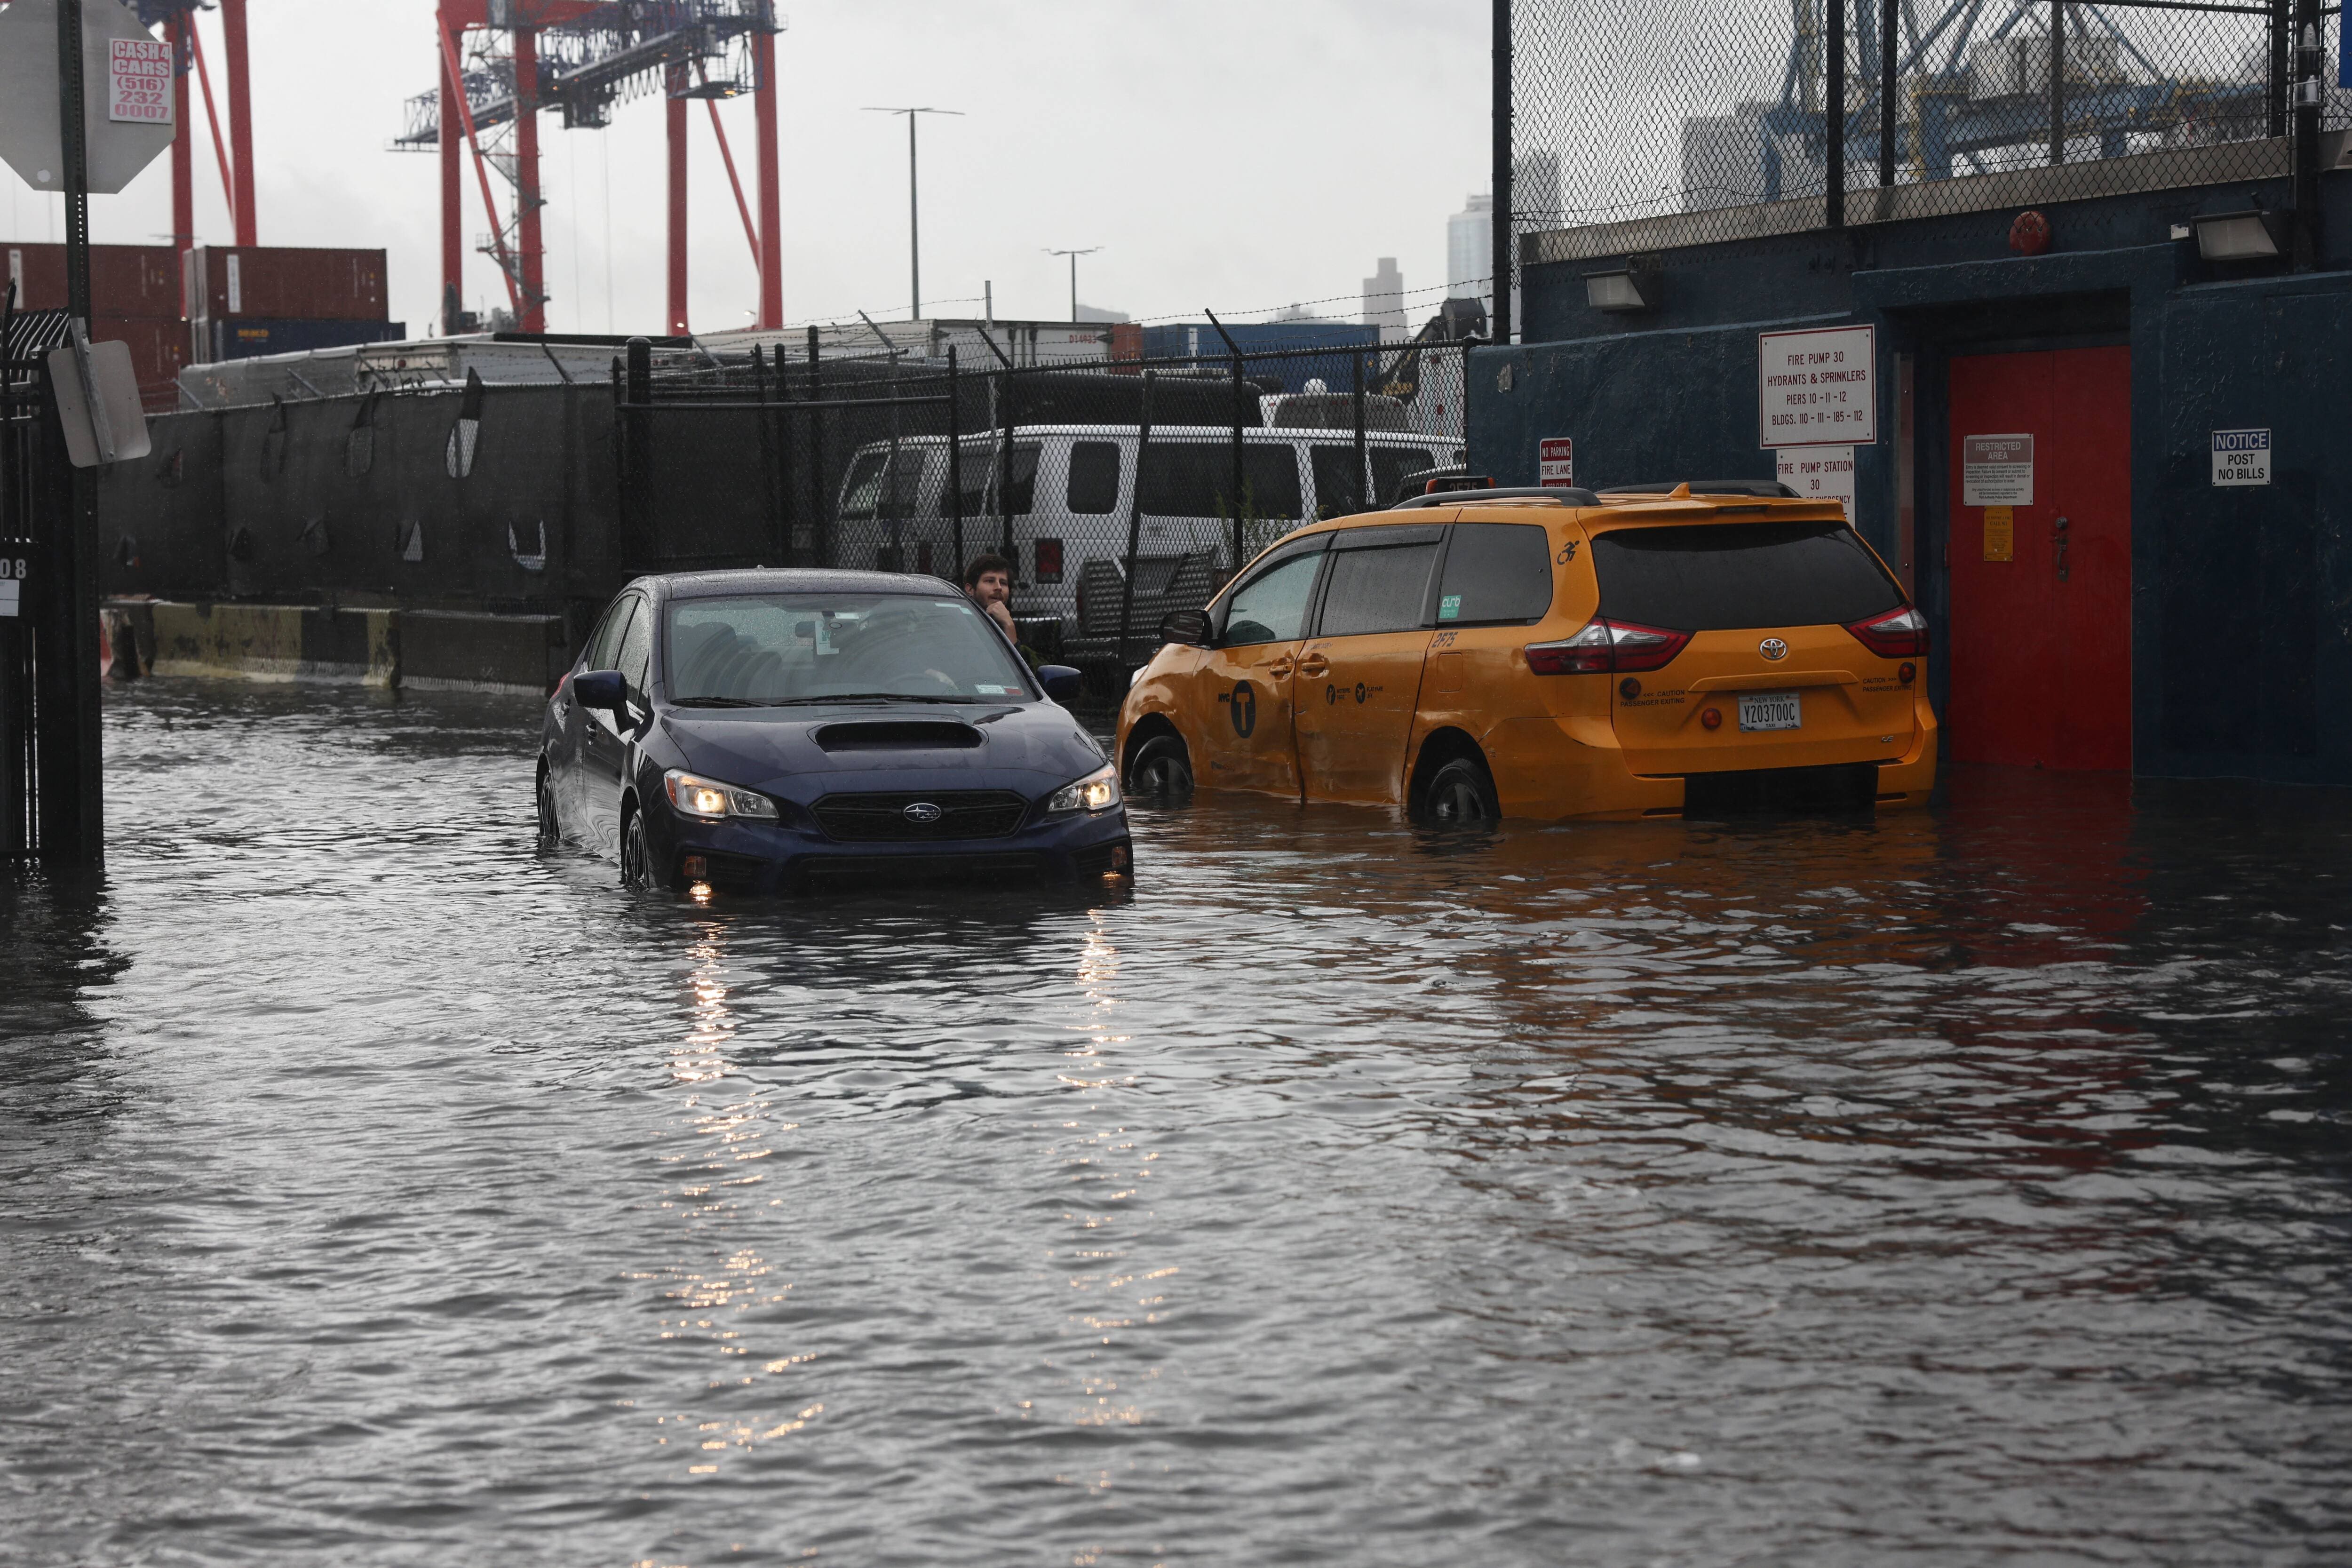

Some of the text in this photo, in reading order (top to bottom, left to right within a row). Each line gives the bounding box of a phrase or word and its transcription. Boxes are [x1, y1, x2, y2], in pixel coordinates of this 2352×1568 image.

[114, 41, 170, 60] CA$H 4
[114, 59, 169, 76] CARS
[117, 76, 165, 91] (516)
[119, 90, 162, 105] 232
[115, 104, 168, 119] 0007
[1788, 351, 1844, 366] FIRE PUMP 30
[1768, 370, 1866, 387] HYDRANTS & SPRINKLERS
[1787, 393, 1806, 405] PIERS
[1810, 393, 1816, 404] 10
[1772, 414, 1796, 425] BLDGS.
[1800, 413, 1808, 424] 110
[1834, 411, 1844, 422] 185
[1854, 410, 1863, 421] 112
[1976, 442, 2021, 451] RESTRICTED
[2216, 433, 2266, 449] NOTICE
[1542, 446, 1570, 457] NO PARKING
[2228, 454, 2255, 465] POST
[1542, 464, 1571, 475] FIRE LANE
[1778, 461, 1853, 474] FIRE PUMP STATION
[2218, 468, 2265, 480] NO BILLS
[1811, 479, 1820, 490] 30
[1442, 596, 1461, 607] curb
[1431, 632, 1458, 648] 2F75
[1218, 693, 1230, 703] NYC
[1744, 702, 1795, 723] Y203700C
